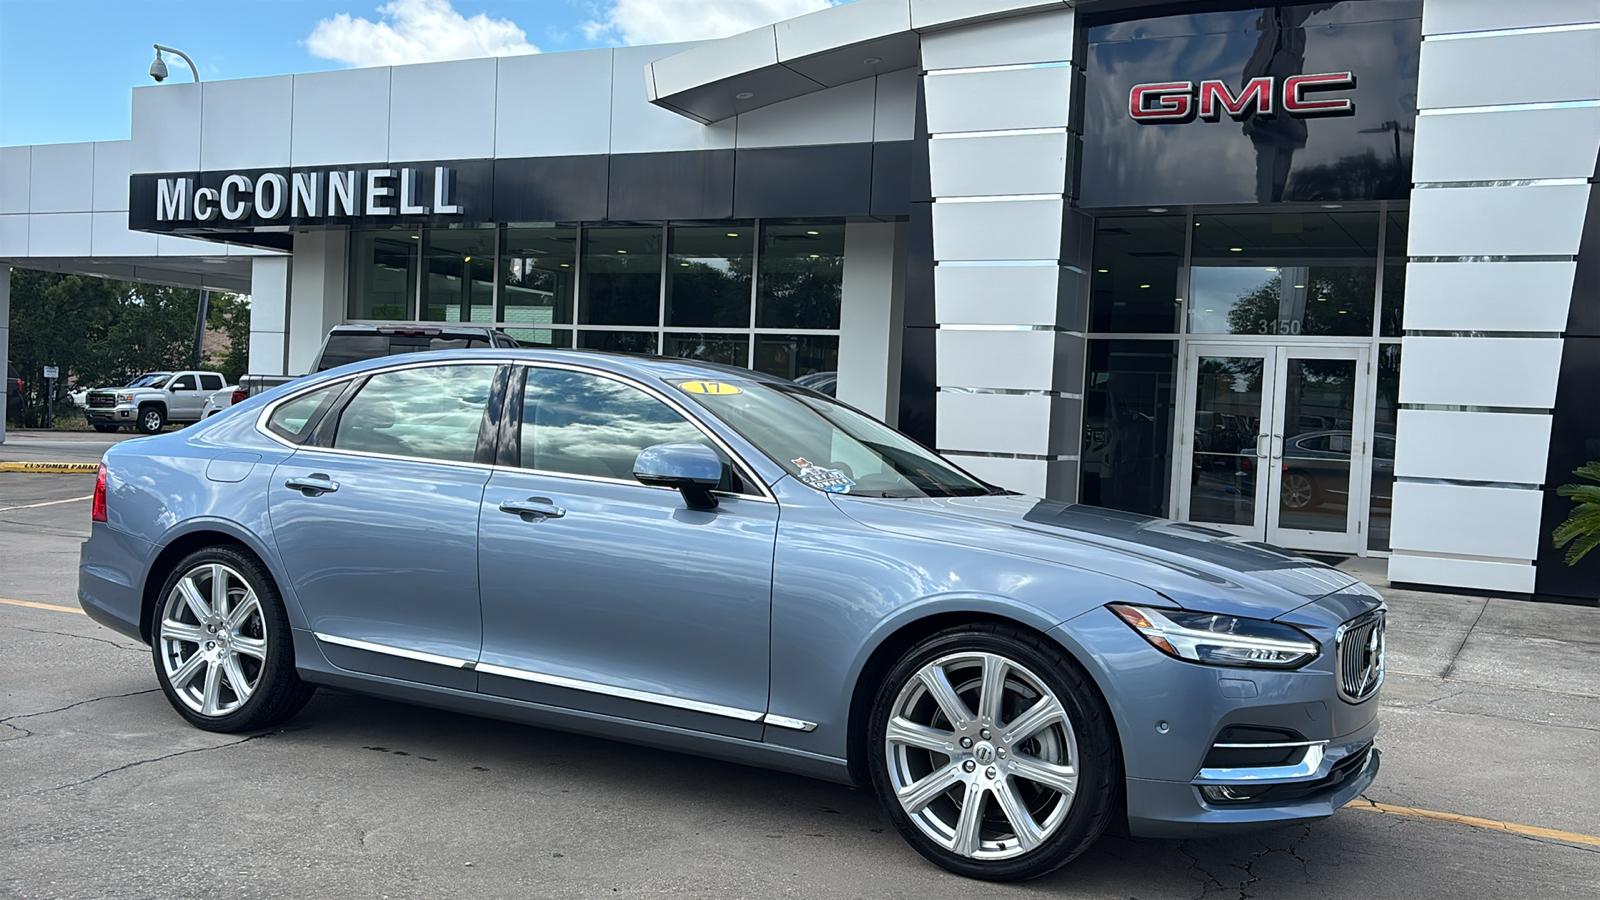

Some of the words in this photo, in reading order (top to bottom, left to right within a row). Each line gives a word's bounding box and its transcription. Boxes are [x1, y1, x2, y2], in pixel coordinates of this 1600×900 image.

[1128, 71, 1356, 121] GMC
[156, 166, 463, 222] McCONNELL
[1258, 319, 1301, 335] 3150
[700, 382, 720, 393] 17
